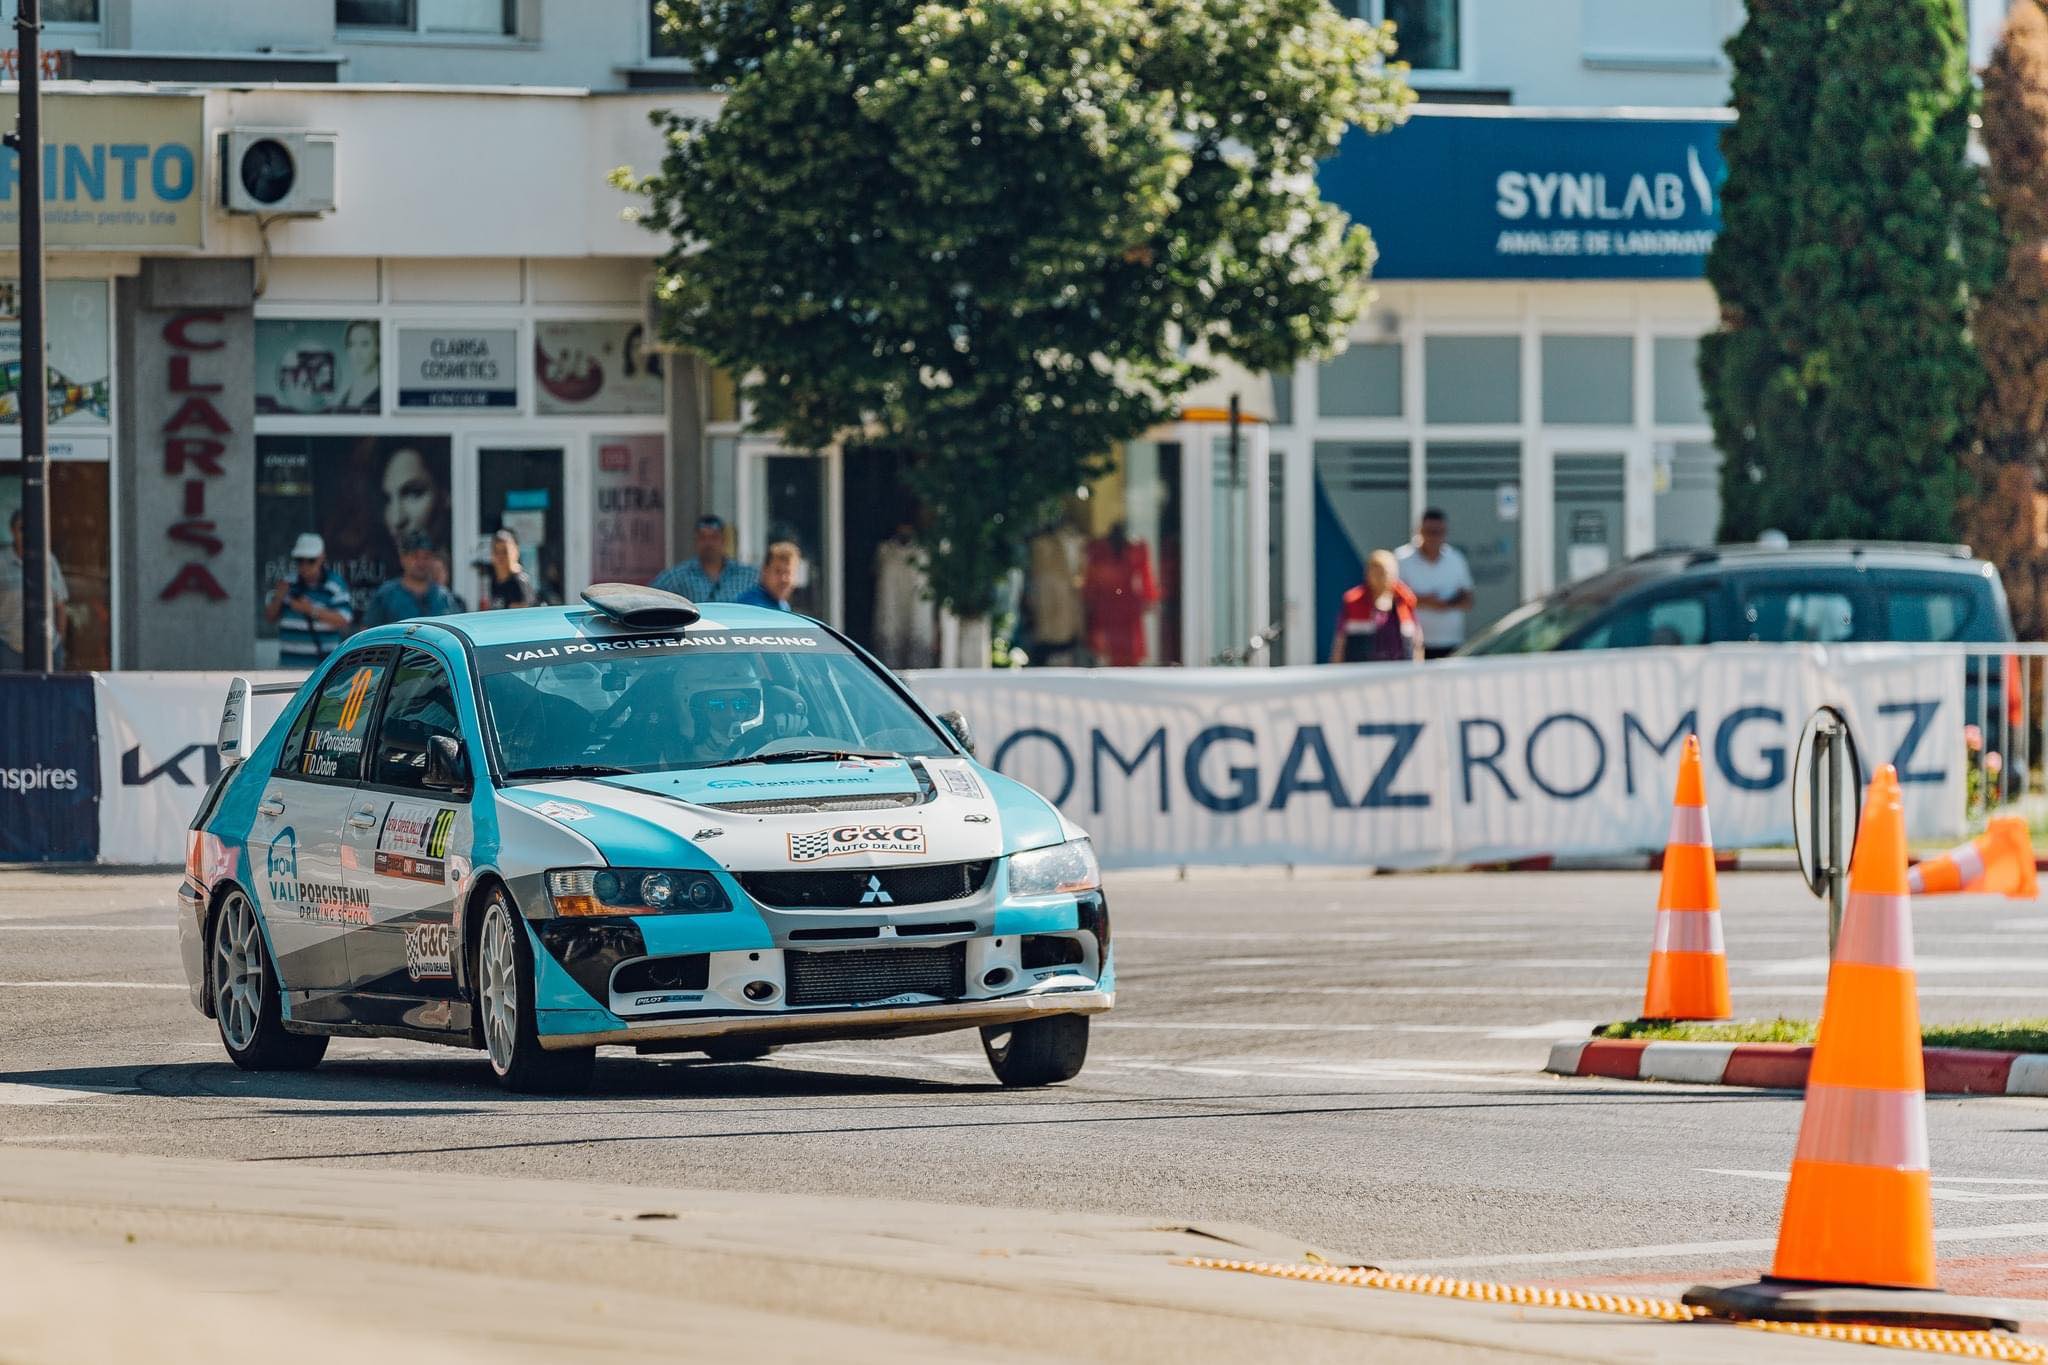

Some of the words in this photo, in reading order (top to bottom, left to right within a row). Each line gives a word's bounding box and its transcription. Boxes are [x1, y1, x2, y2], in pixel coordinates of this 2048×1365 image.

[1496, 171, 1686, 220] SYNLAB
[1496, 230, 1580, 255] ANALIZE
[1582, 230, 1610, 255] DE
[430, 337, 489, 358] CLARISA
[420, 359, 499, 380] COSMETICS
[158, 311, 234, 604] CLARISA
[598, 486, 664, 512] ULTRA
[505, 647, 560, 663] VALI
[564, 636, 728, 655] PORCISTEANU
[731, 635, 818, 648] RACING
[337, 668, 373, 731] 10
[993, 722, 1432, 815] OMGAZ
[1459, 700, 1947, 804] ROMGZ
[430, 810, 455, 858] 10
[832, 827, 919, 842] G&C
[832, 842, 870, 852] AUTO
[872, 842, 922, 851] DEALER
[299, 905, 334, 920] DRIVING
[338, 908, 369, 925] SCHOOL
[418, 926, 448, 957] G&C
[637, 996, 663, 1005] PILOT
